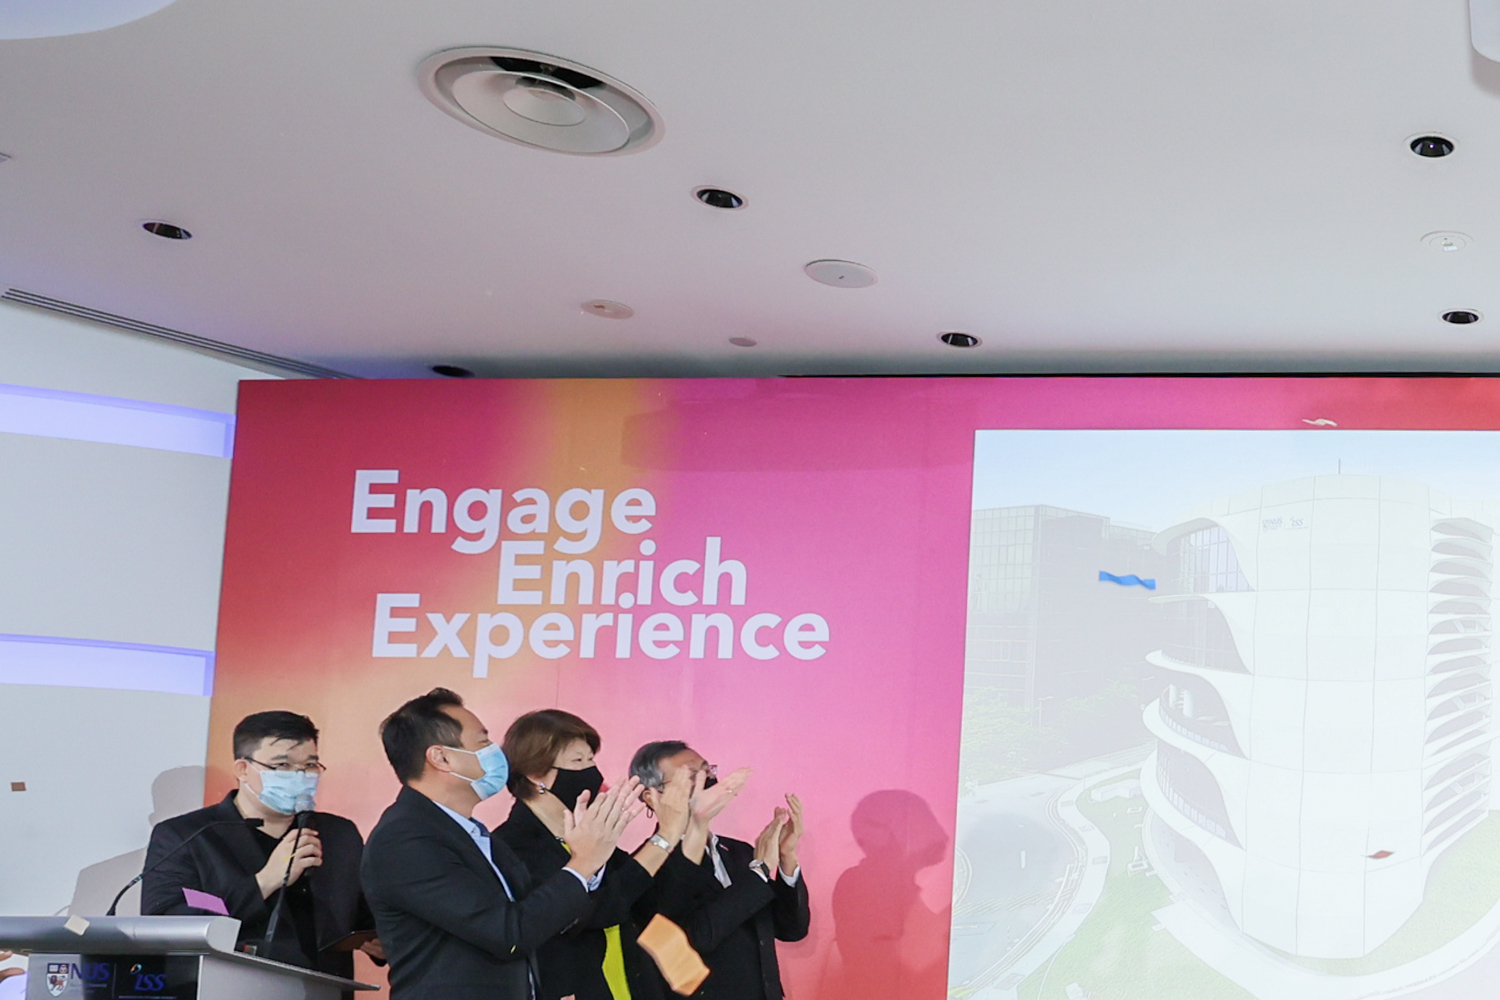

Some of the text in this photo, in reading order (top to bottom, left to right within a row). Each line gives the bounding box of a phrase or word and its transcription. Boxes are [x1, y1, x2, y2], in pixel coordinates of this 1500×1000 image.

[351, 469, 657, 554] Engage
[497, 536, 748, 606] Enrich
[371, 592, 831, 678] Experience
[70, 962, 111, 981] NUS
